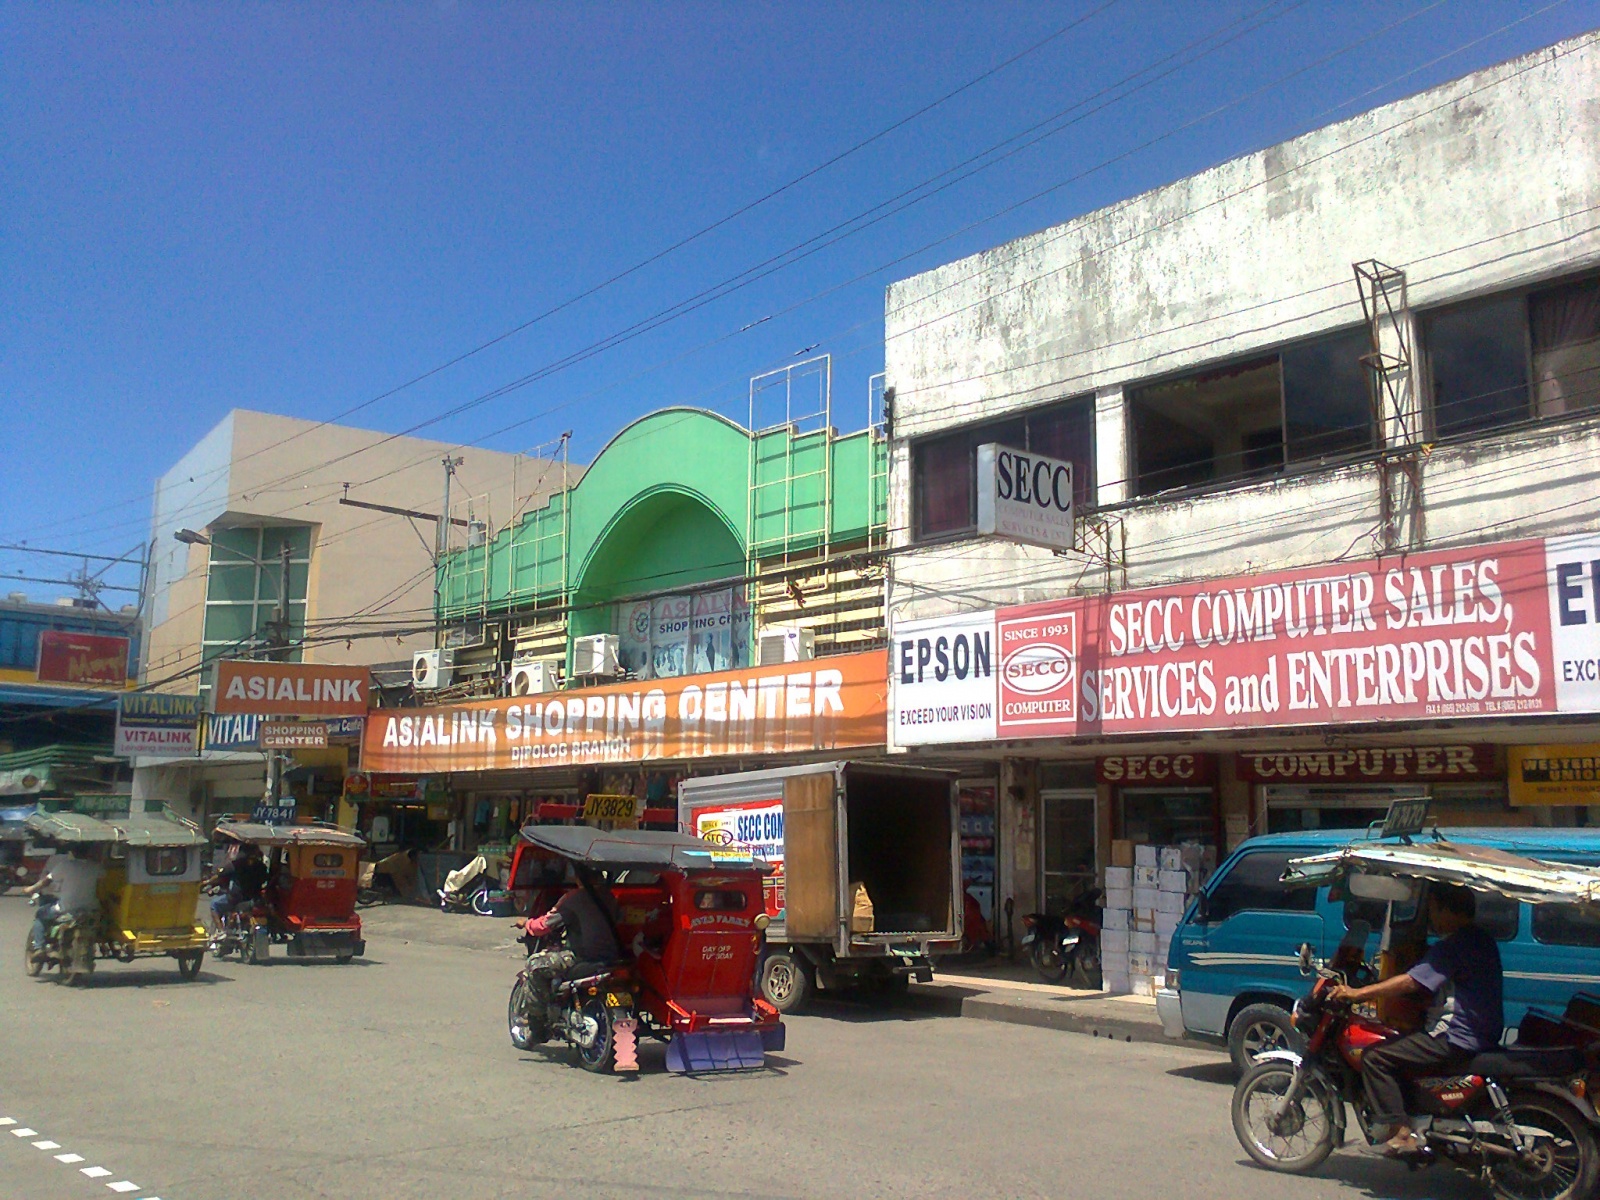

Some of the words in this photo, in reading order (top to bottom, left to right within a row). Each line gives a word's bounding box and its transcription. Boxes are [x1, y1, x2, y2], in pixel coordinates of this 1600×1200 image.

[998, 451, 1070, 512] SECC
[1556, 559, 1600, 626] E
[1109, 596, 1184, 656] SECC
[1191, 571, 1376, 648] COMPUTER
[1384, 558, 1513, 634] SALES,
[659, 617, 715, 633] SHOPING
[1004, 628, 1038, 641] SINCE
[1041, 624, 1069, 638] 1993
[901, 631, 991, 684] EPSON
[1008, 660, 1065, 678] SECC
[1081, 659, 1216, 723] SERVICES
[1224, 655, 1279, 714] and
[1287, 631, 1540, 710] ENTERPRISES
[1563, 659, 1600, 681] EXC
[225, 676, 362, 702] ASIALINK
[123, 695, 196, 715] VITALINK
[383, 708, 497, 747] ASIALINK
[505, 688, 666, 740] SHOPPING
[679, 669, 844, 725] CENTER
[900, 708, 934, 725] EXCEED
[936, 706, 959, 722] YOUR
[960, 703, 992, 720] VISION
[1005, 699, 1071, 715] COMPUTER
[124, 730, 191, 743] VITALINK
[208, 714, 270, 745] VITALI
[265, 726, 324, 735] SHOPPING
[265, 736, 324, 745] CENTER
[512, 742, 567, 760] DIPOLOG
[571, 737, 630, 756] BRANCH
[1103, 755, 1194, 780] SECC
[1254, 746, 1479, 777] COMPUTER
[738, 814, 762, 841] SECC
